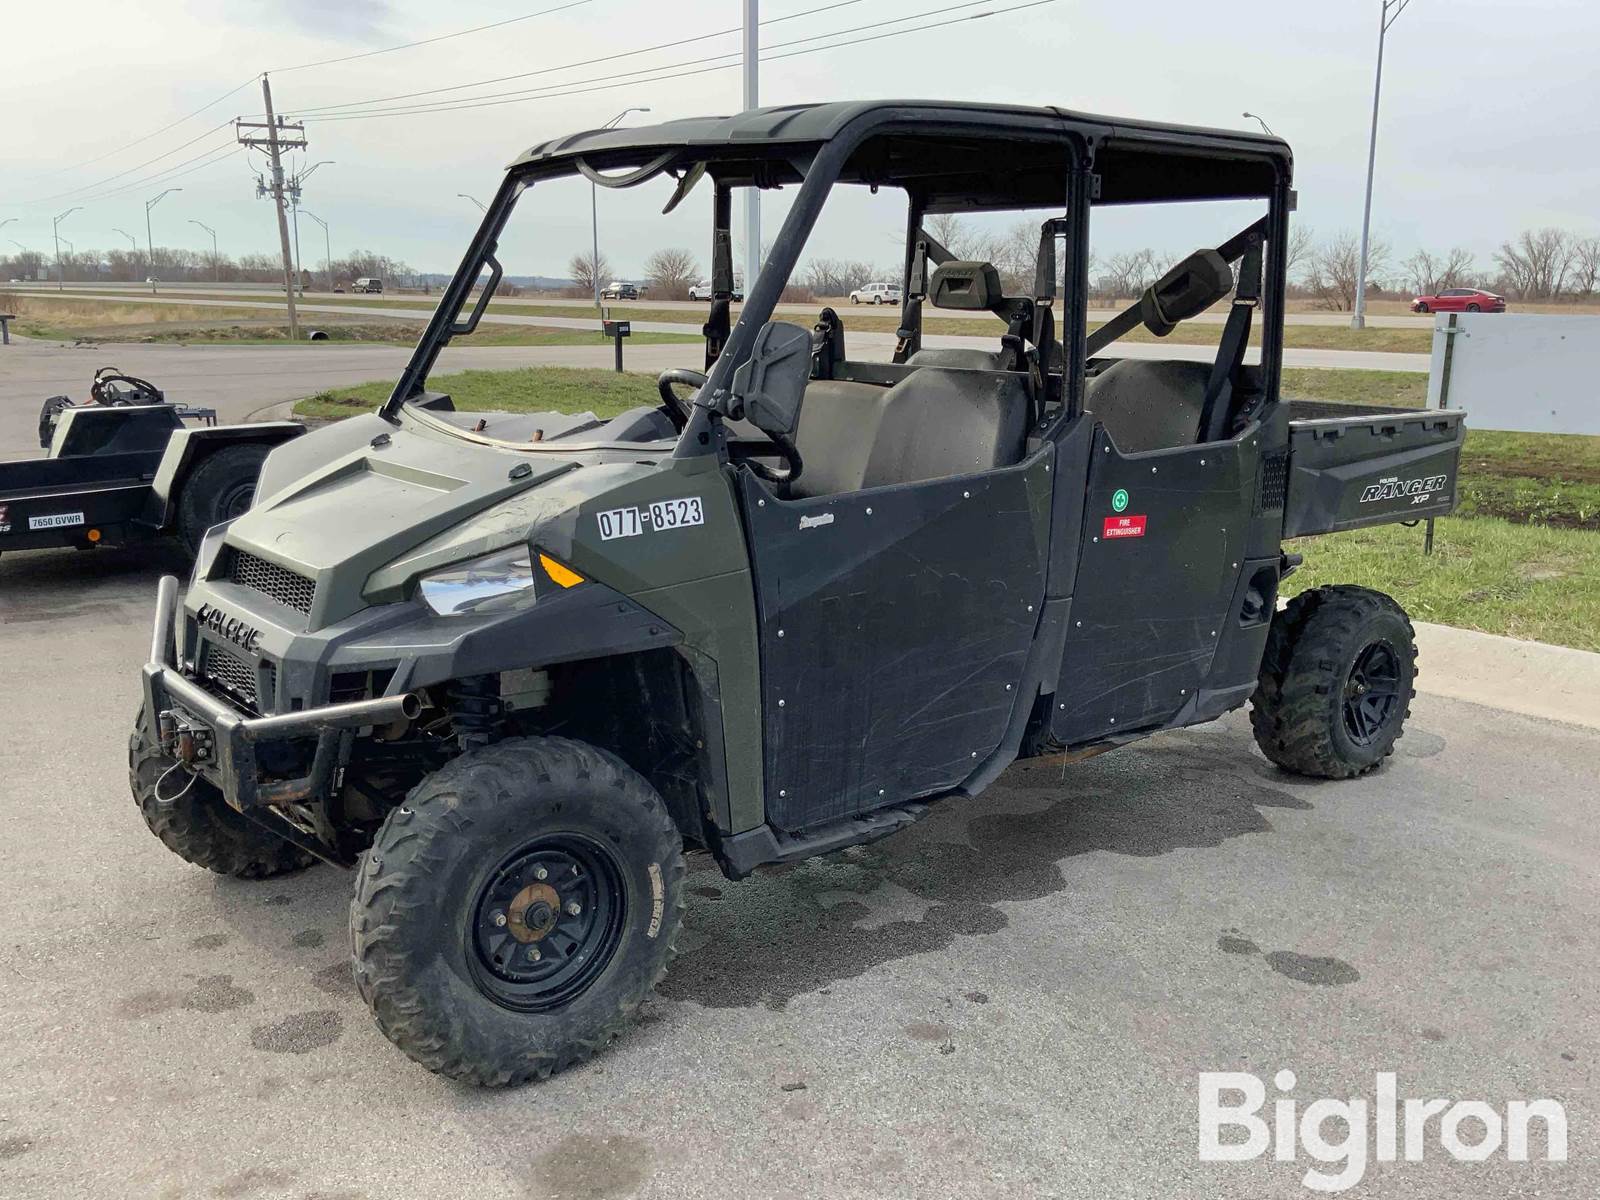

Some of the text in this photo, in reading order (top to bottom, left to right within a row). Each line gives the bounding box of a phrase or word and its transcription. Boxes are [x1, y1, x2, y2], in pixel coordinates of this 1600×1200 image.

[1360, 475, 1447, 502] RANGER
[1411, 494, 1430, 504] XP
[33, 515, 81, 527] 7650 GVWR
[600, 499, 702, 538] 077-8523
[1119, 519, 1131, 527] FIRE
[1106, 527, 1141, 536] EXTINGUISHER
[197, 602, 265, 656] POLARIS
